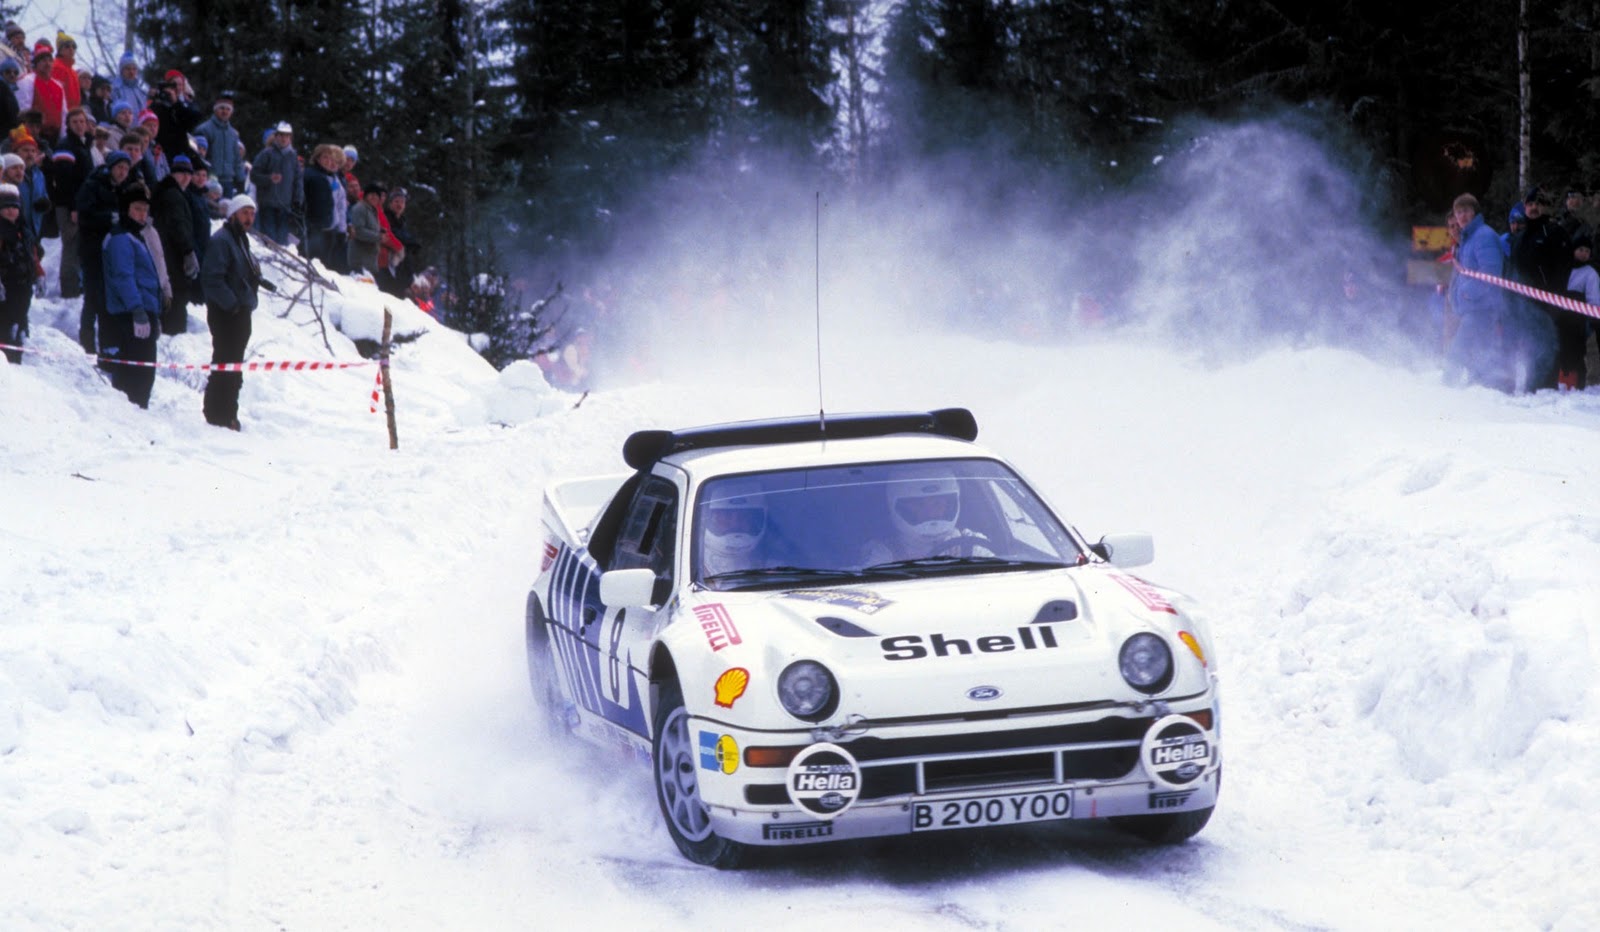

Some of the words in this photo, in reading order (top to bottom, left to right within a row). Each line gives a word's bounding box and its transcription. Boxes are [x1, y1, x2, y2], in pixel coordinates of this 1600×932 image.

[692, 603, 742, 652] PIRELLI
[880, 626, 1058, 661] Shell
[1154, 744, 1205, 764] Hella
[798, 774, 853, 790] Hella
[915, 805, 933, 828] B
[942, 799, 1003, 826] 200
[762, 820, 834, 840] PIRELLI
